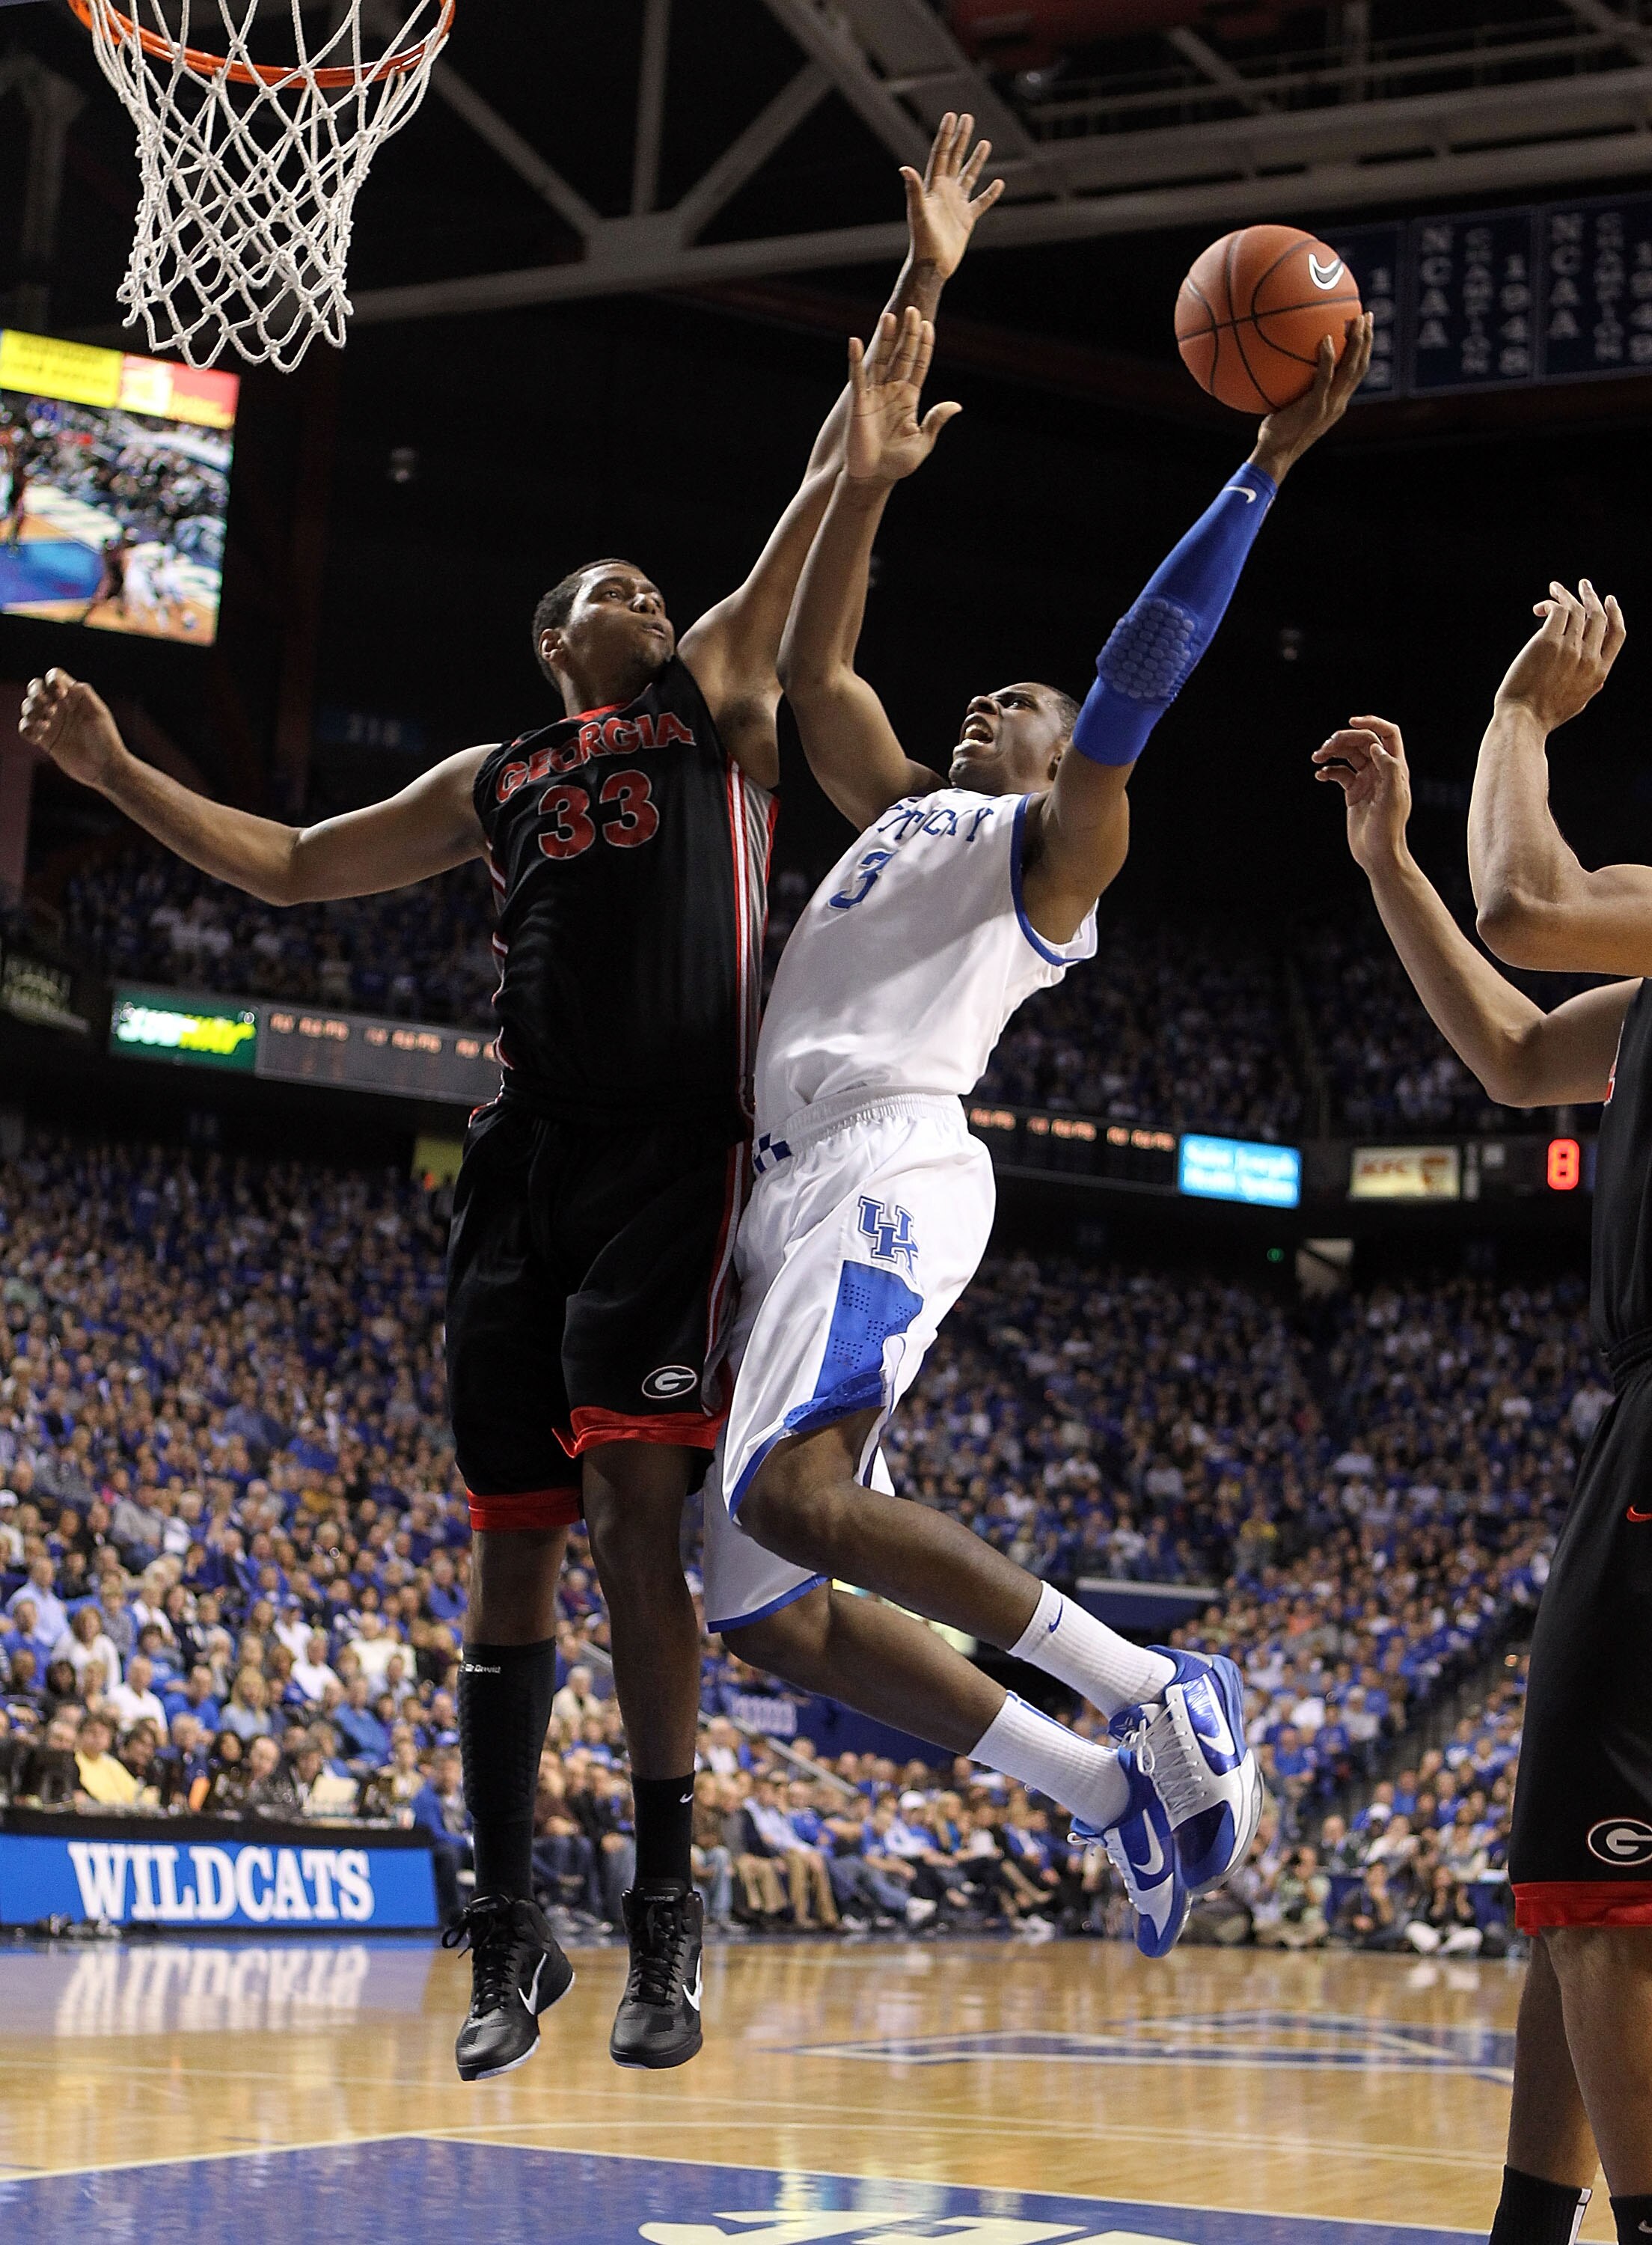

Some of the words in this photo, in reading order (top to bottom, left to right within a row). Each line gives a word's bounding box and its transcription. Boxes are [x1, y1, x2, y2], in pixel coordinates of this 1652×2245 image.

[495, 712, 697, 803] GEORGIA
[538, 769, 660, 861] 33
[828, 850, 894, 909] 3
[1547, 1138, 1579, 1190] 8
[652, 1369, 697, 1393] G
[1601, 1824, 1652, 1858] G
[67, 1841, 375, 1922] WILDCATS
